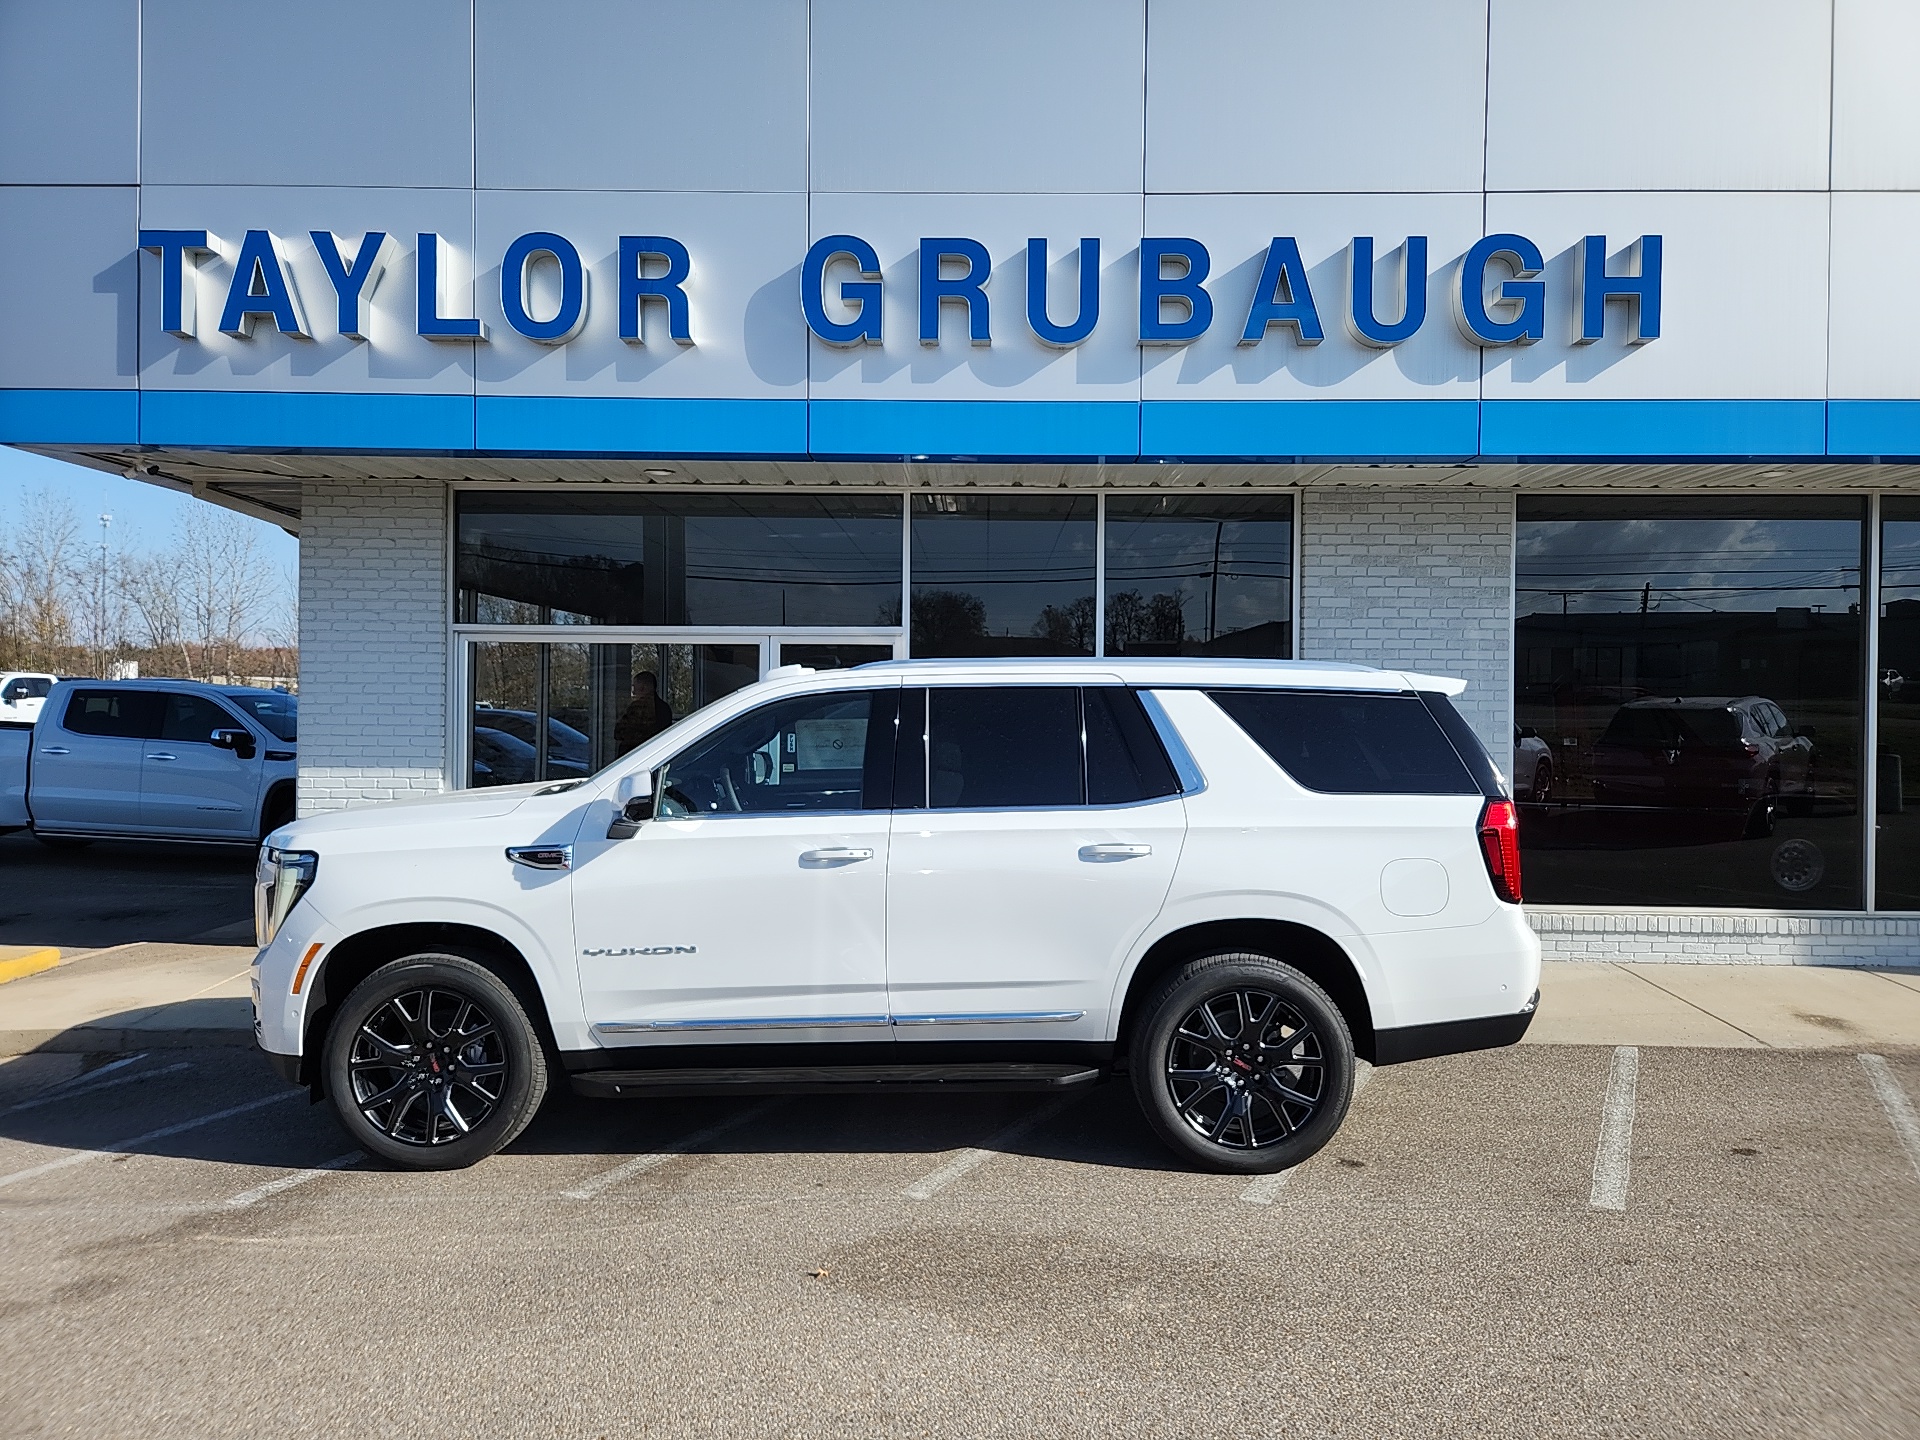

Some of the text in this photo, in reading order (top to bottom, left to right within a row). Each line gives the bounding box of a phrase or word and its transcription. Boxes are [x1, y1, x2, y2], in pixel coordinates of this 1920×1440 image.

[138, 229, 1663, 348] TAYLOR GRUBAUGH
[582, 945, 697, 957] YUKON
